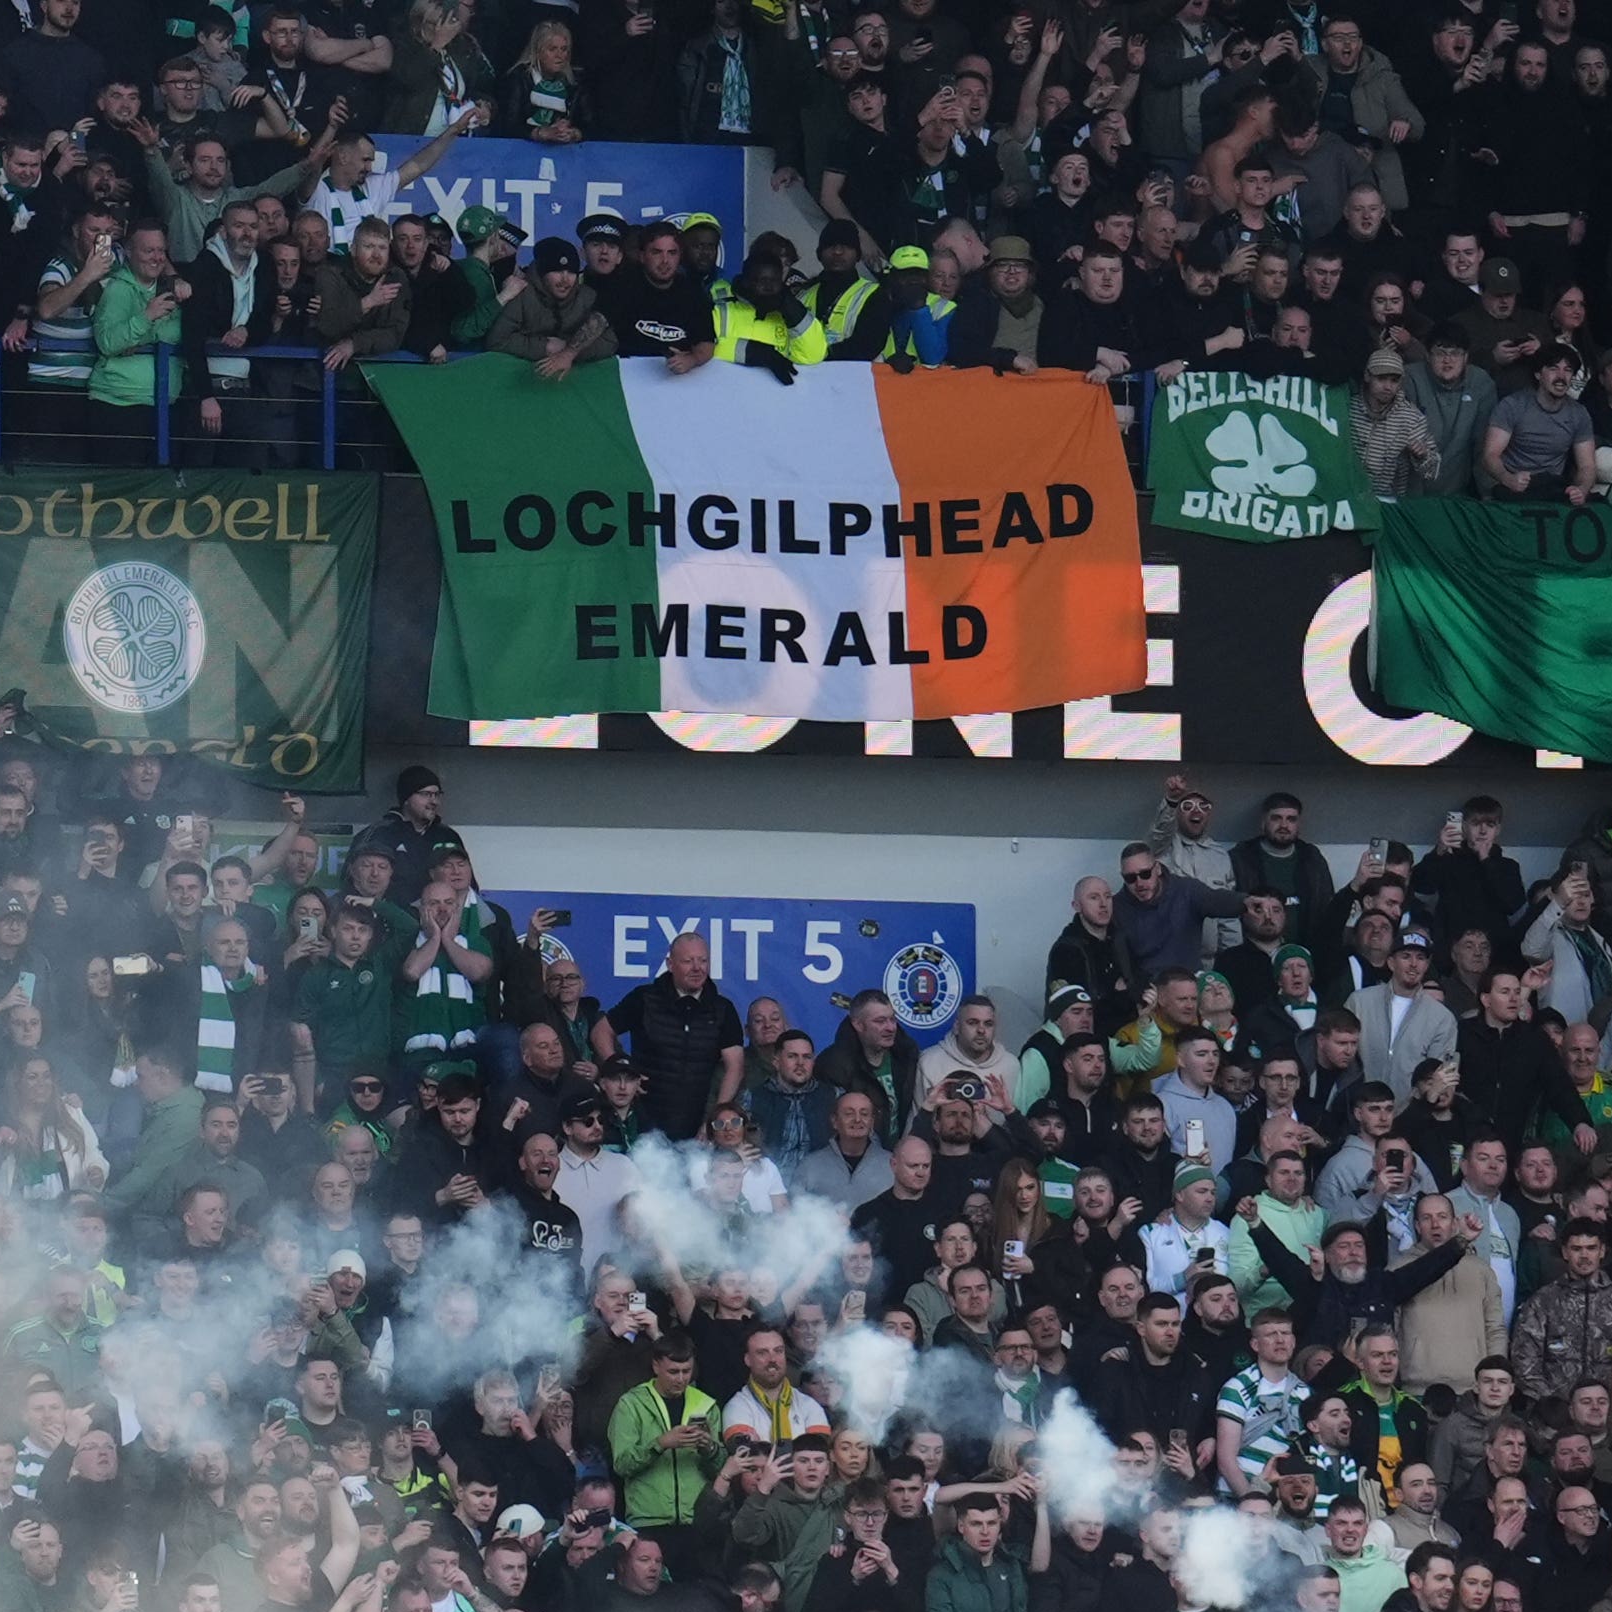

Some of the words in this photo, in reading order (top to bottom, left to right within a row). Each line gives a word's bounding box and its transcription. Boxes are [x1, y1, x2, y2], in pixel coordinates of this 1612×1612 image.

[450, 482, 1095, 558] LOCHGILPHEAD
[70, 570, 122, 625] BOTHWELL
[124, 566, 180, 596] EMERALD
[576, 603, 989, 667] EMERALD
[613, 915, 775, 981] EXIT
[802, 920, 843, 984] 5
